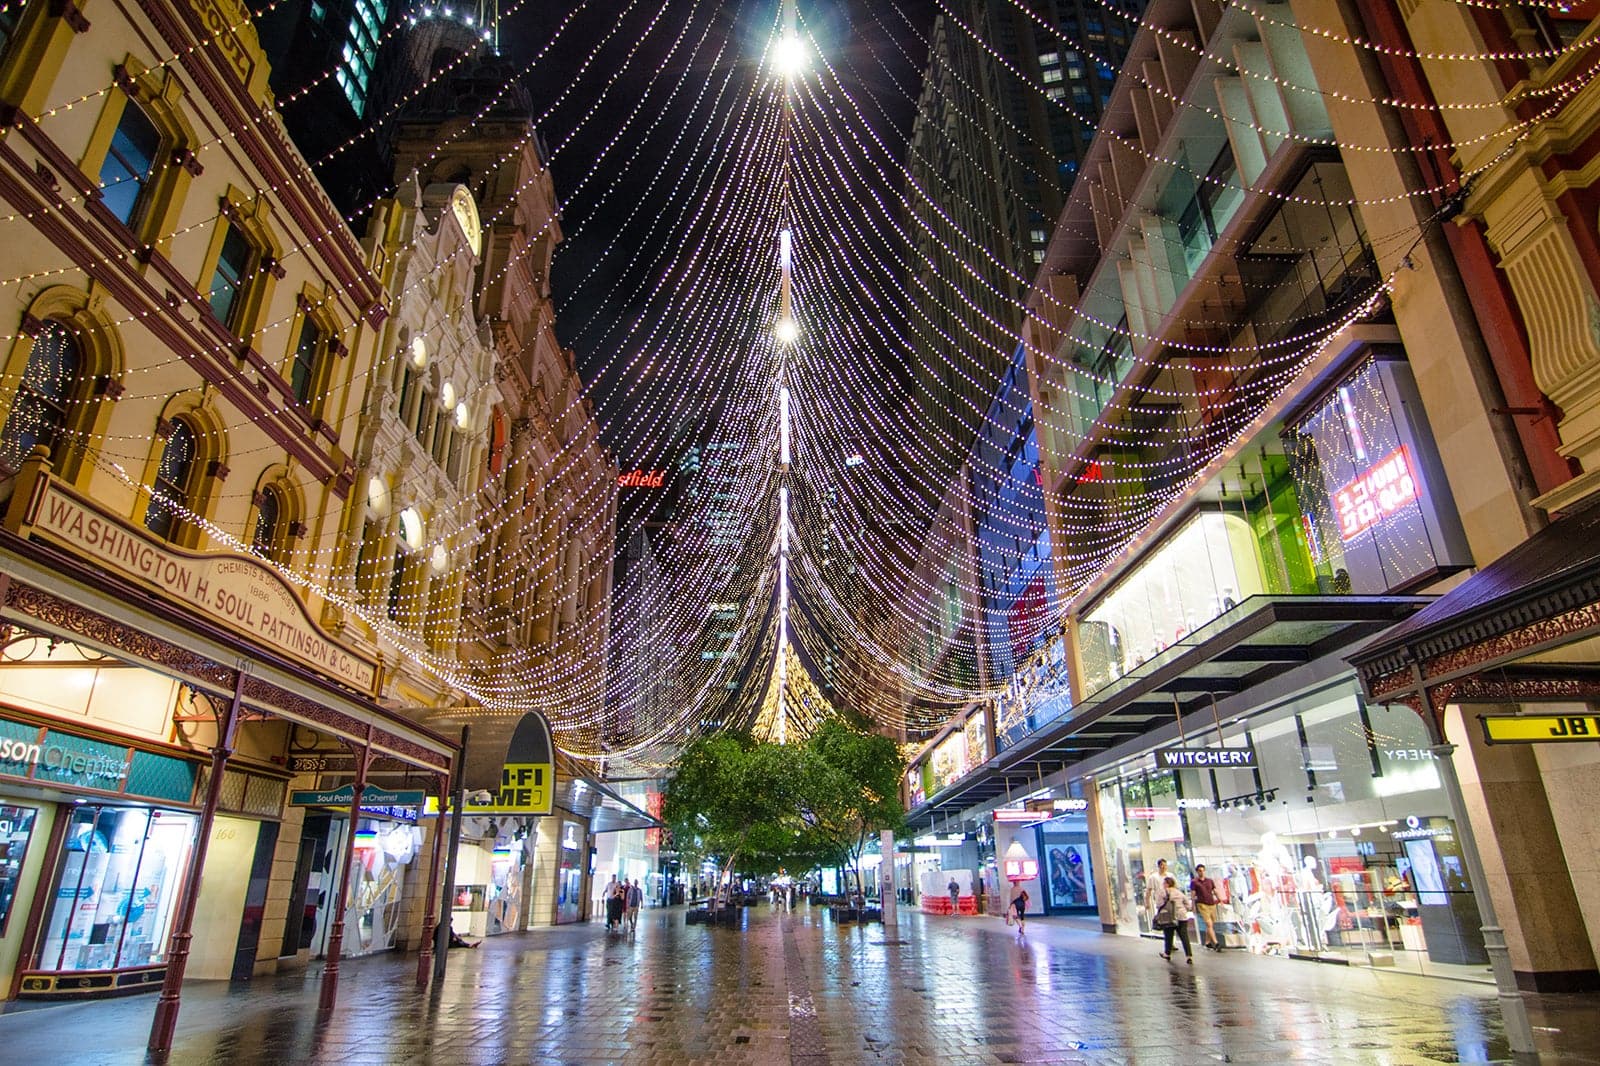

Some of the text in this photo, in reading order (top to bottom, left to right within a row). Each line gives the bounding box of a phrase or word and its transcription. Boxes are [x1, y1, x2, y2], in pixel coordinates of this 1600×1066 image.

[49, 495, 193, 594] WASHINGTON
[194, 577, 211, 605] H.
[215, 589, 255, 628] SOUL
[260, 612, 329, 663] PATTINSON
[329, 650, 337, 667] &
[217, 562, 257, 578] CHEMISTS
[265, 575, 297, 616] DRUGGISTS
[1549, 717, 1589, 736] JB
[0, 737, 130, 779] son Chemist
[1164, 751, 1252, 765] WITCHERY
[369, 794, 398, 802] Chemist
